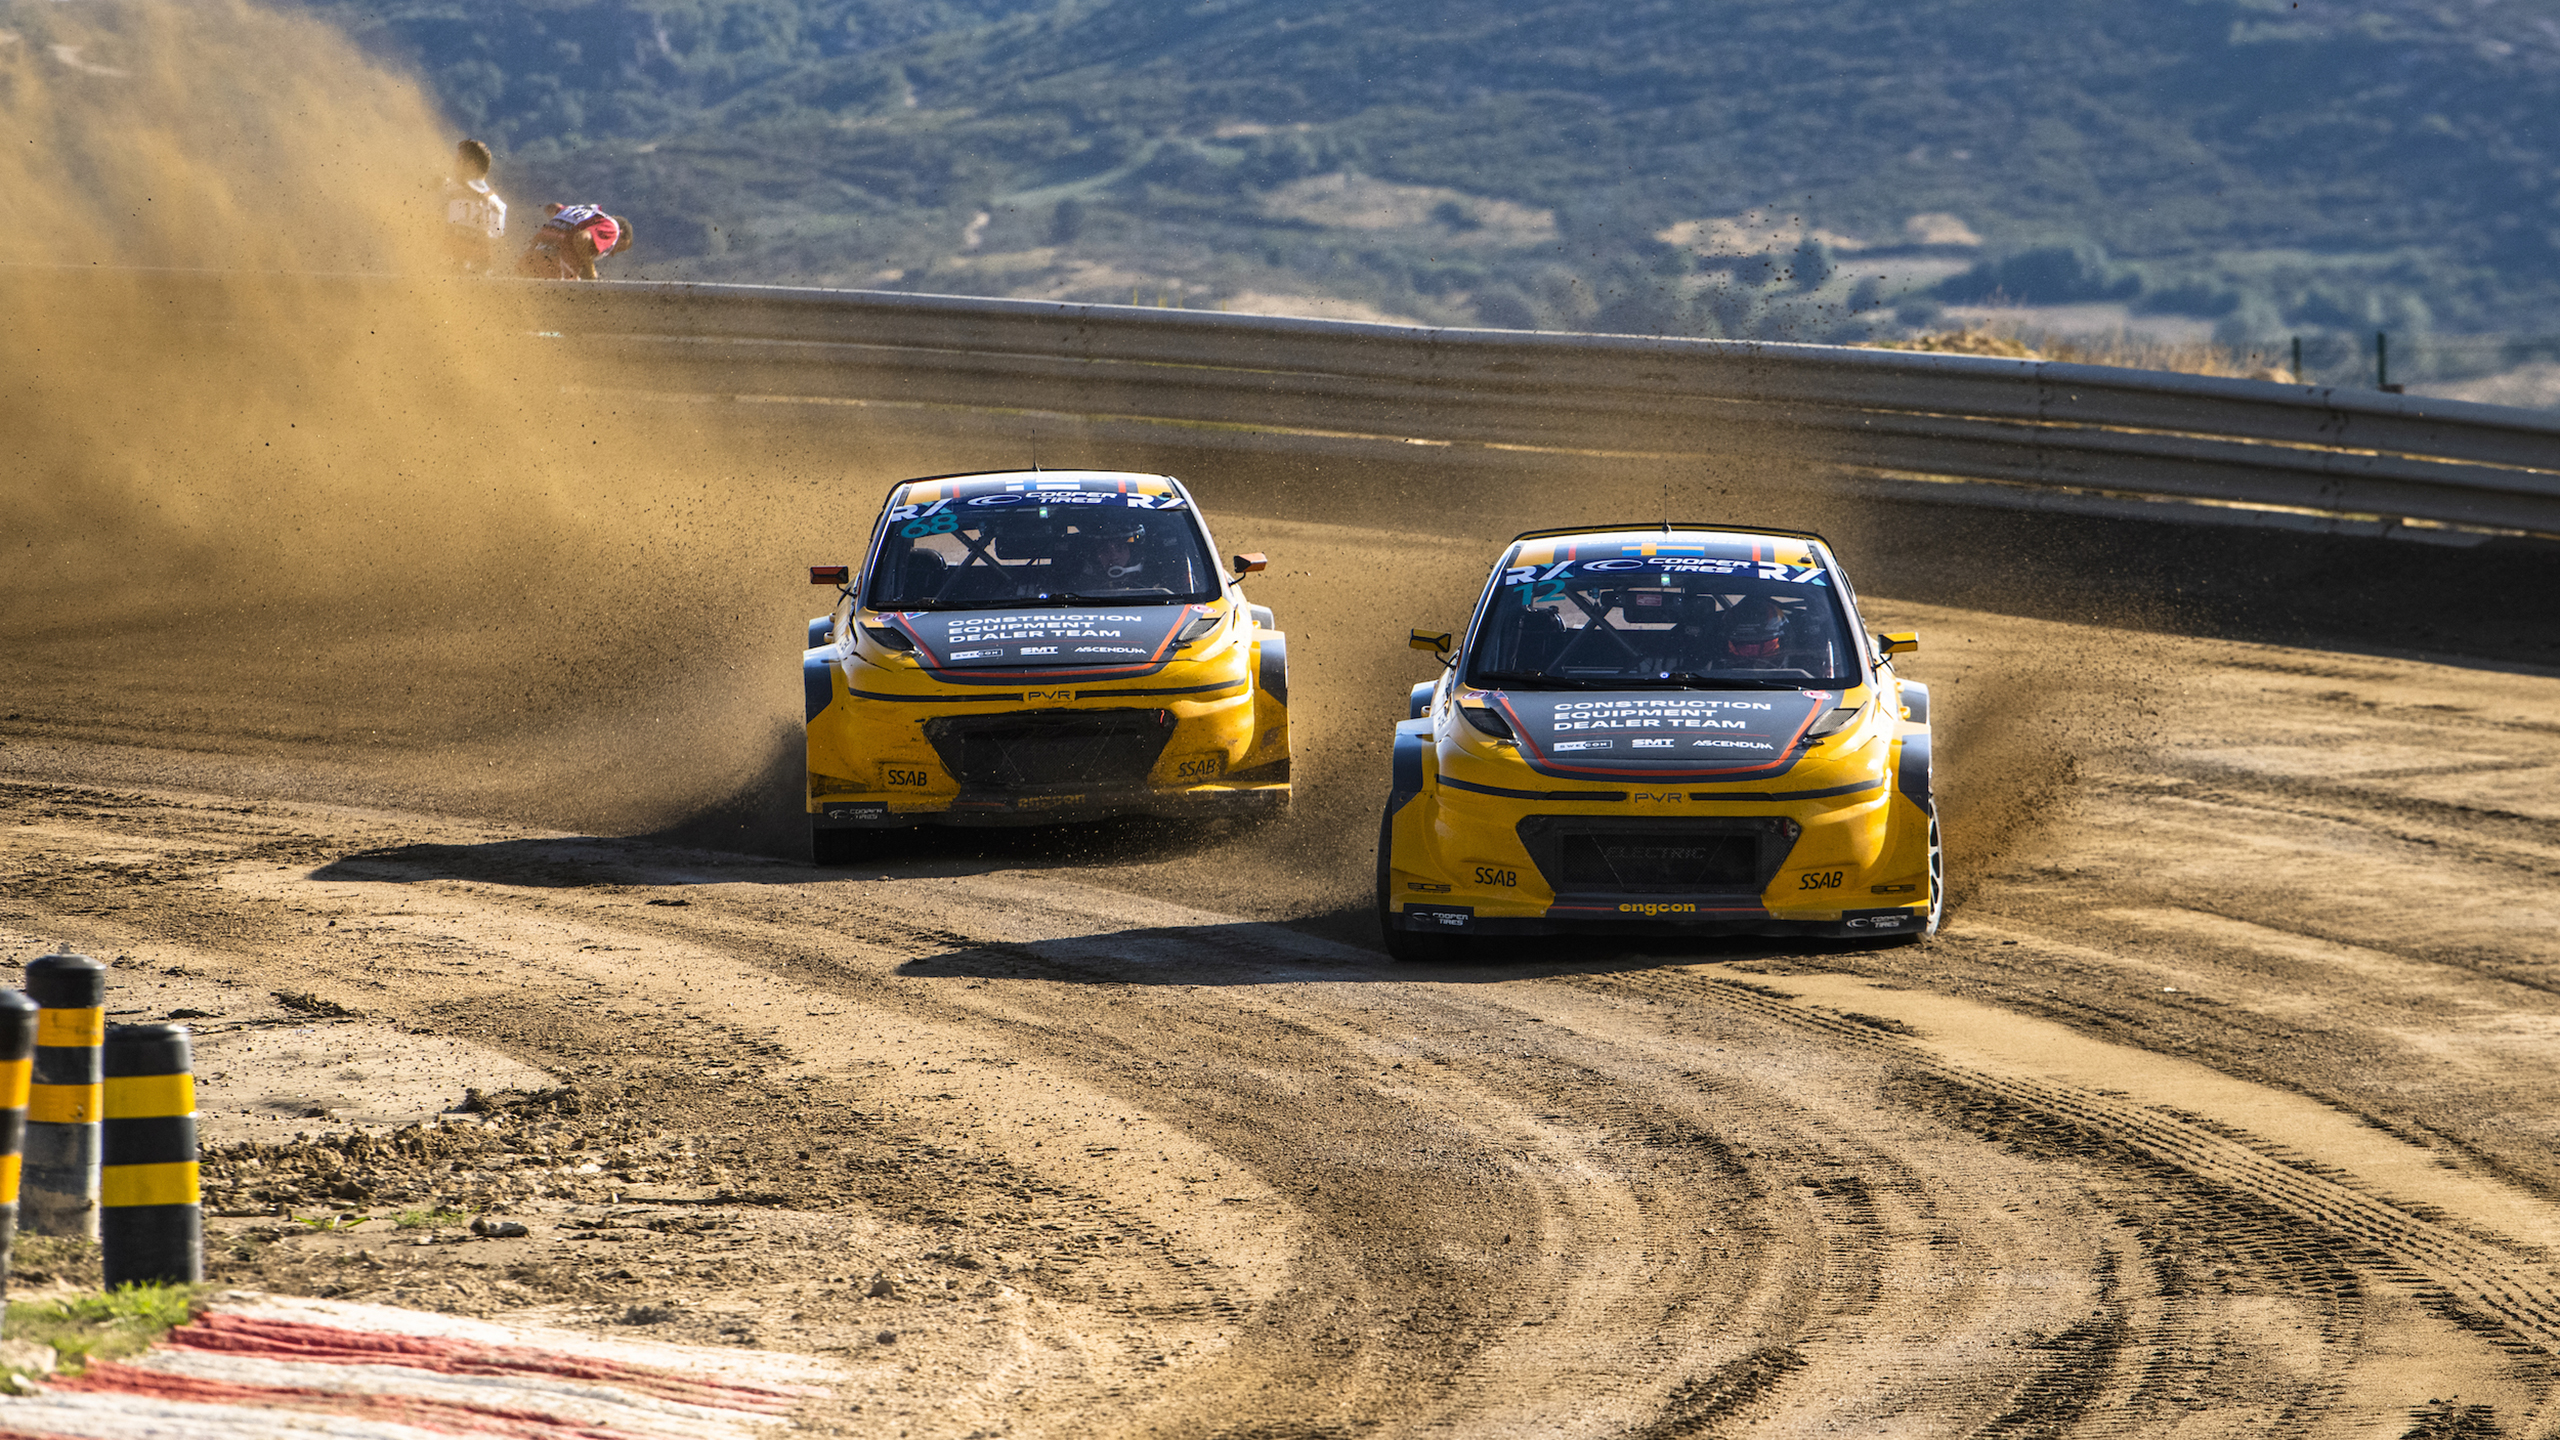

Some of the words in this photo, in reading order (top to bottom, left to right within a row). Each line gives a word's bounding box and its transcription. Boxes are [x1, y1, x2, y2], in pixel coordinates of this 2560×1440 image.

[901, 514, 959, 539] 68
[1648, 557, 1751, 568] COOPER
[1661, 565, 1734, 574] TIRES
[1513, 579, 1566, 606] 12
[948, 614, 1142, 626] CONSTRUCTION
[948, 621, 1095, 634] EQUIPMENT
[949, 630, 1044, 643] DEALER
[1051, 629, 1121, 638] TEAM
[1075, 646, 1147, 654] ASCENDUM
[1554, 700, 1771, 711] CONSTRUCTION
[1554, 709, 1718, 720] EQUIPMENT
[1554, 718, 1661, 731] DEALER
[1667, 718, 1746, 729] TEAM
[1632, 739, 1675, 747] SMT
[1692, 740, 1774, 750] ASCENDUM
[1177, 759, 1217, 778] SSAB
[888, 769, 928, 787] SSAB
[1475, 867, 1517, 887] SSAB
[1798, 871, 1844, 890] SSAB
[1432, 912, 1469, 920] COOPER
[1618, 903, 1696, 917] engcon
[1875, 921, 1900, 929] TIRES
